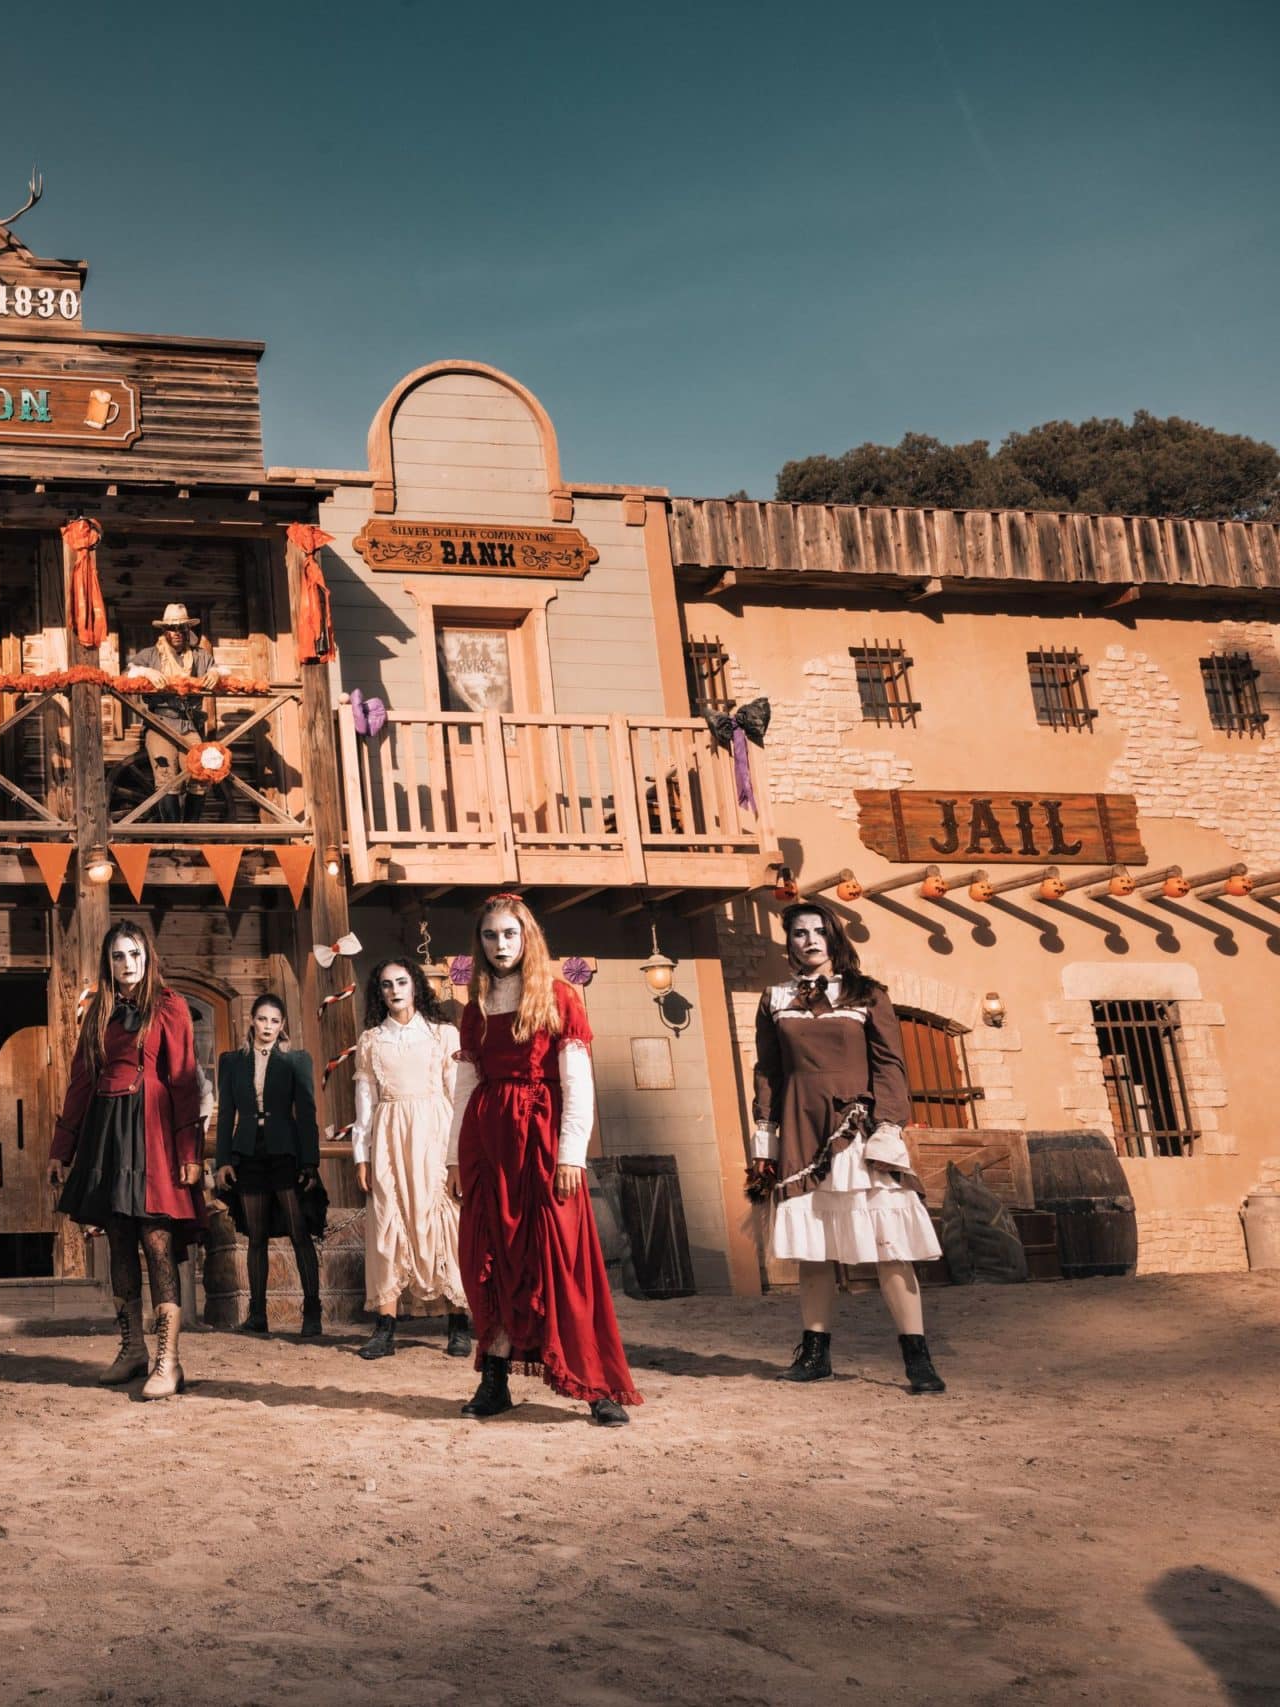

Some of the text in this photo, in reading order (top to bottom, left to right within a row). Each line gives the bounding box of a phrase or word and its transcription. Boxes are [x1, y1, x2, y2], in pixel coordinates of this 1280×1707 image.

[391, 526, 429, 536] SILVER
[433, 528, 477, 538] DOLLAR
[480, 530, 531, 541] COMPANY
[440, 540, 516, 567] BANK
[928, 799, 1083, 856] JAIL
